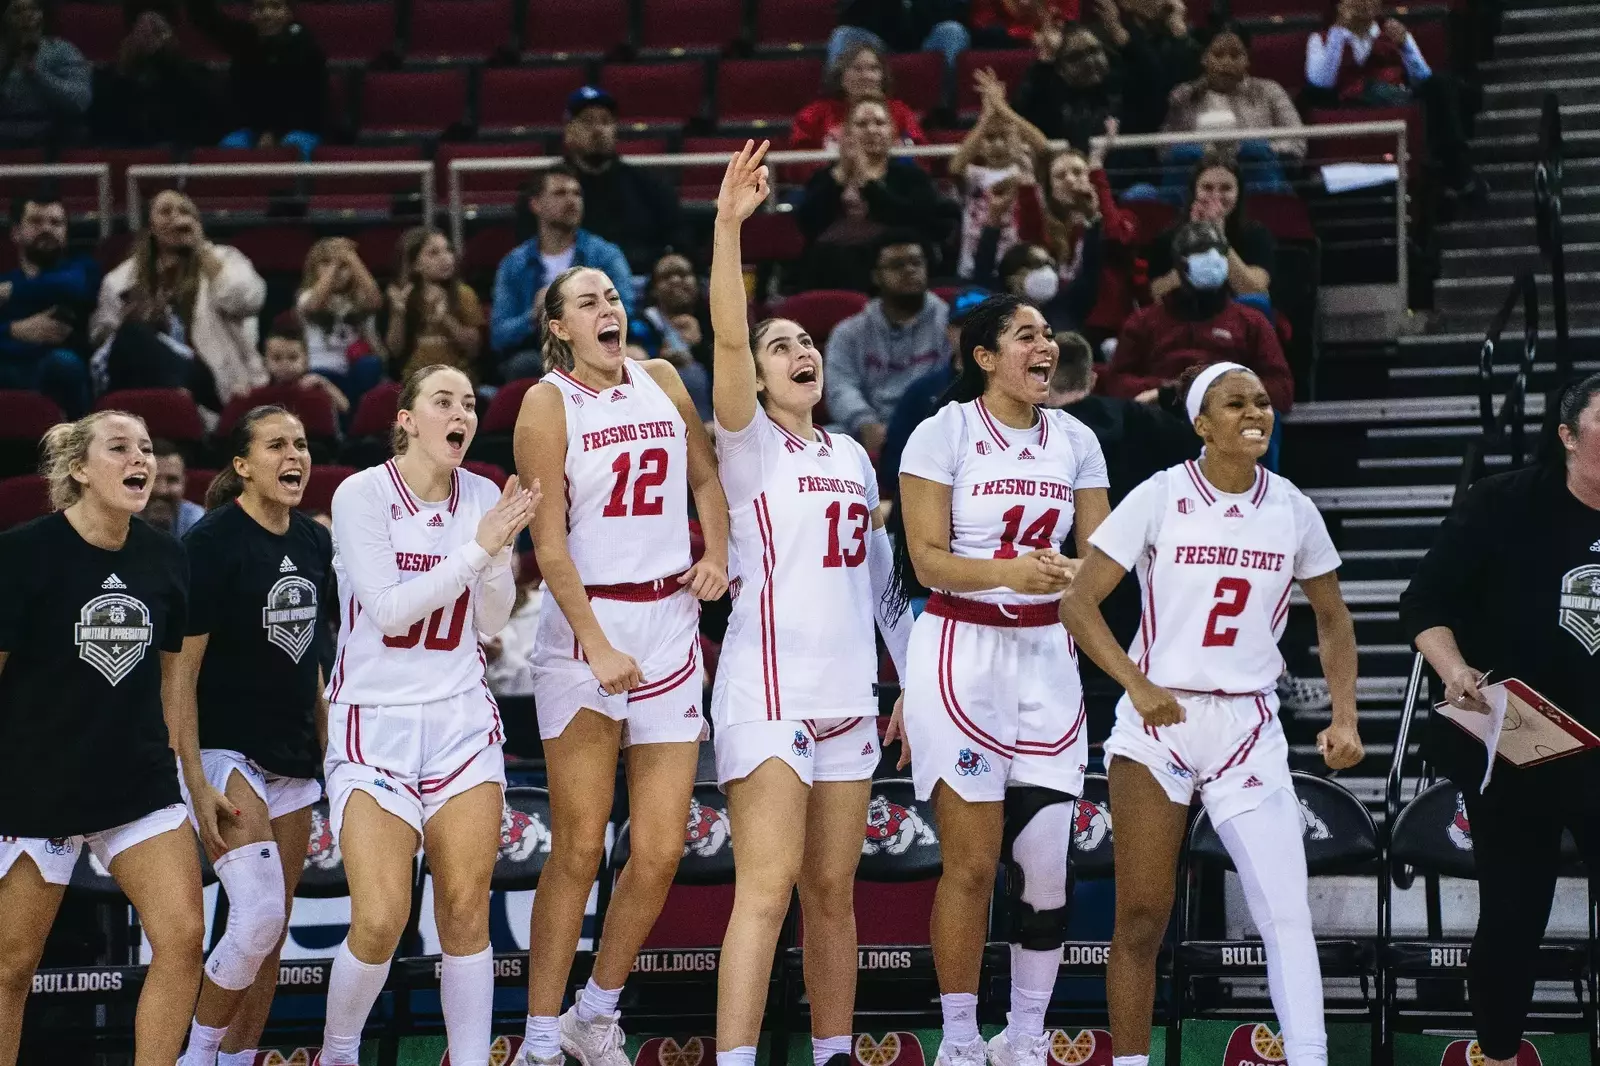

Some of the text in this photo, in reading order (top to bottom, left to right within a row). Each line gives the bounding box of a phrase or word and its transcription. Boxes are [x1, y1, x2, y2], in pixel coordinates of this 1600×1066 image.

[582, 420, 676, 452] FRESNO STATE
[602, 447, 669, 517] 12
[798, 475, 846, 494] FRESNO
[971, 478, 1073, 503] FRESNO STATE
[822, 500, 870, 568] 13
[993, 505, 1061, 560] 14
[395, 552, 442, 572] RESNO
[1174, 546, 1285, 572] FRESNO STATE
[101, 582, 127, 590] adidas
[1201, 576, 1252, 647] 2
[630, 953, 716, 972] BULLDOGS
[858, 951, 911, 969] LDOGS
[1059, 946, 1111, 965] LDOGS
[1221, 947, 1267, 965] BULL
[31, 971, 123, 993] BULLDOGS
[279, 966, 323, 985] DOGS
